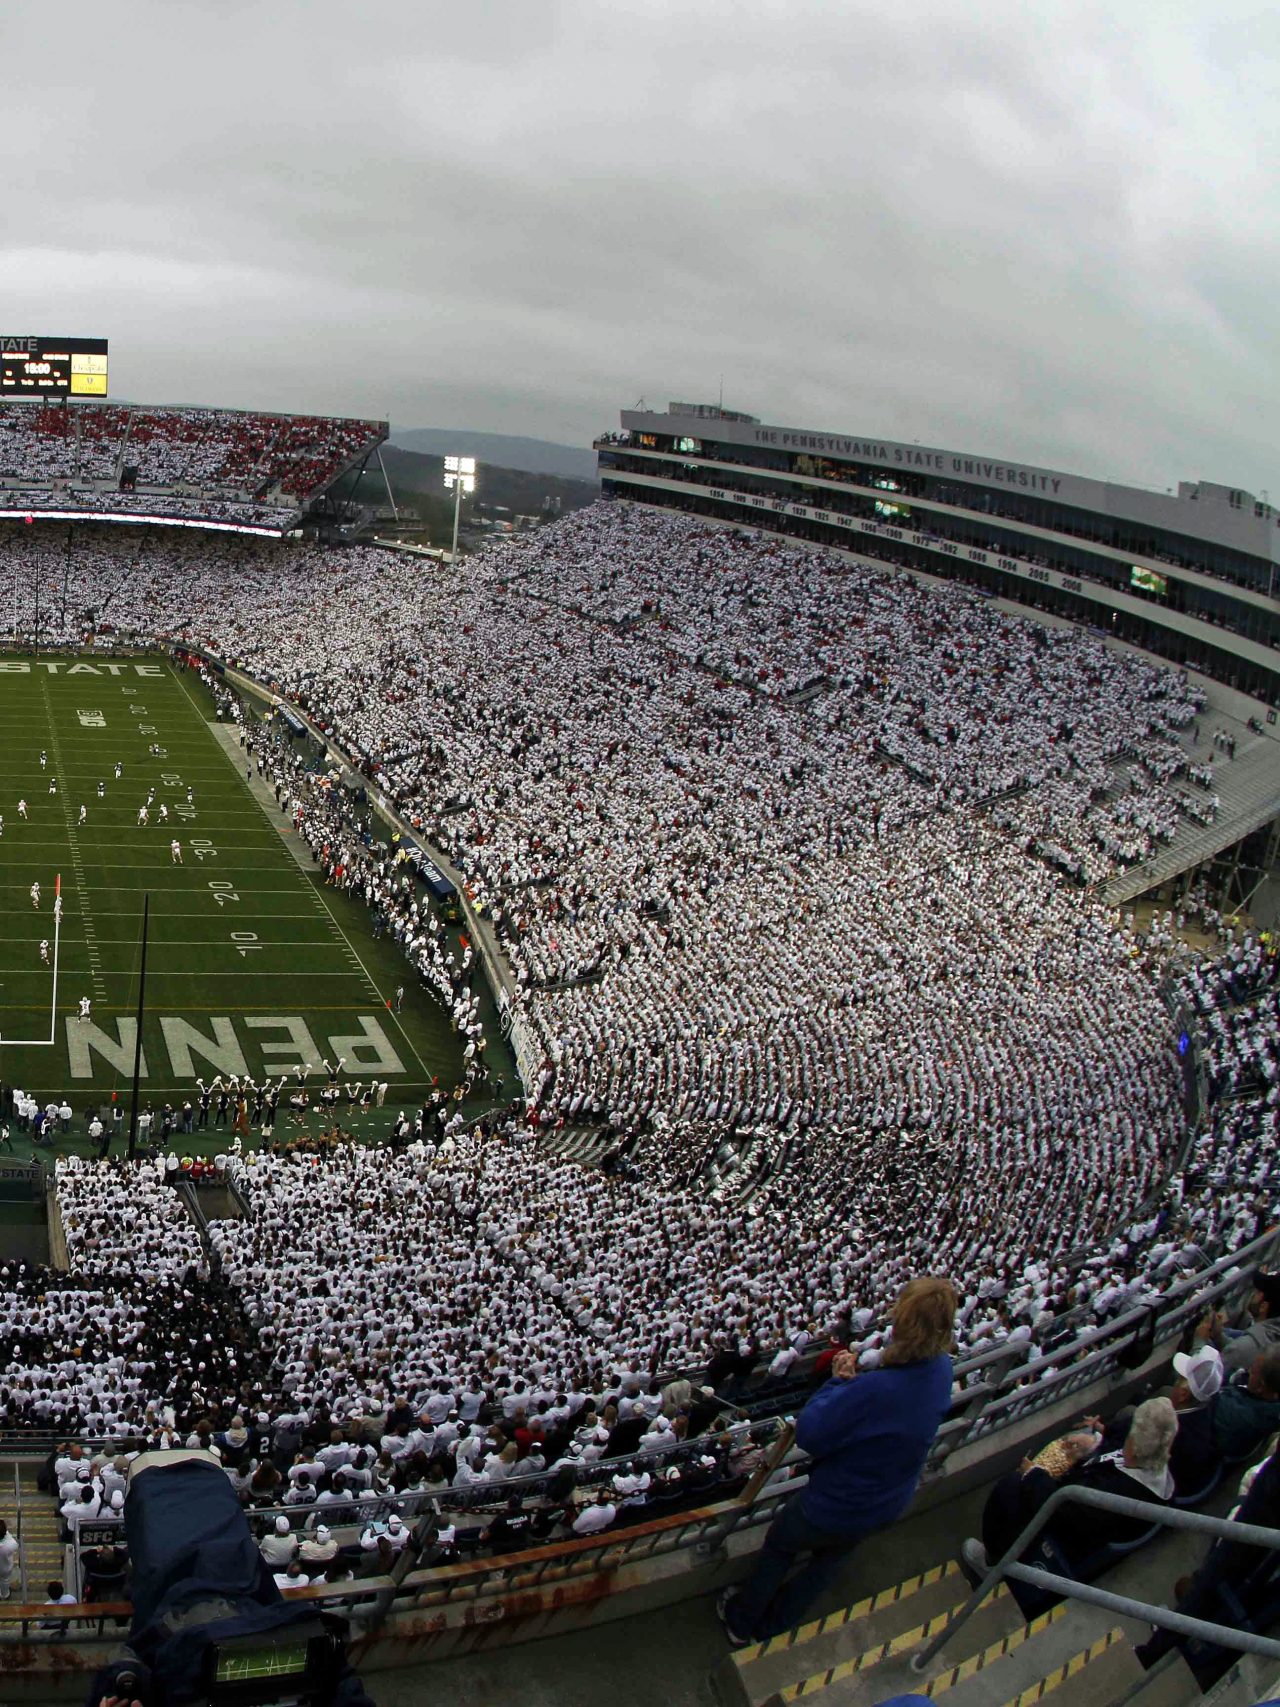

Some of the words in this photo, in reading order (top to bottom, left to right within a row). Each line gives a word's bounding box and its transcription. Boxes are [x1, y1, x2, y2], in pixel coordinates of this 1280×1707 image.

[754, 430, 777, 443] THE
[783, 433, 888, 459] PENNSYLVANIA
[894, 448, 944, 470] STATE
[953, 458, 1062, 494] UNIVERSITY
[160, 773, 184, 787] 50
[174, 803, 198, 819] 40
[189, 839, 218, 857] 30
[208, 881, 241, 901] 20
[230, 931, 263, 950] 10
[64, 1015, 407, 1078] PENN
[1, 1168, 40, 1179] STATE
[259, 1436, 270, 1454] 2
[81, 1531, 114, 1543] SFC
